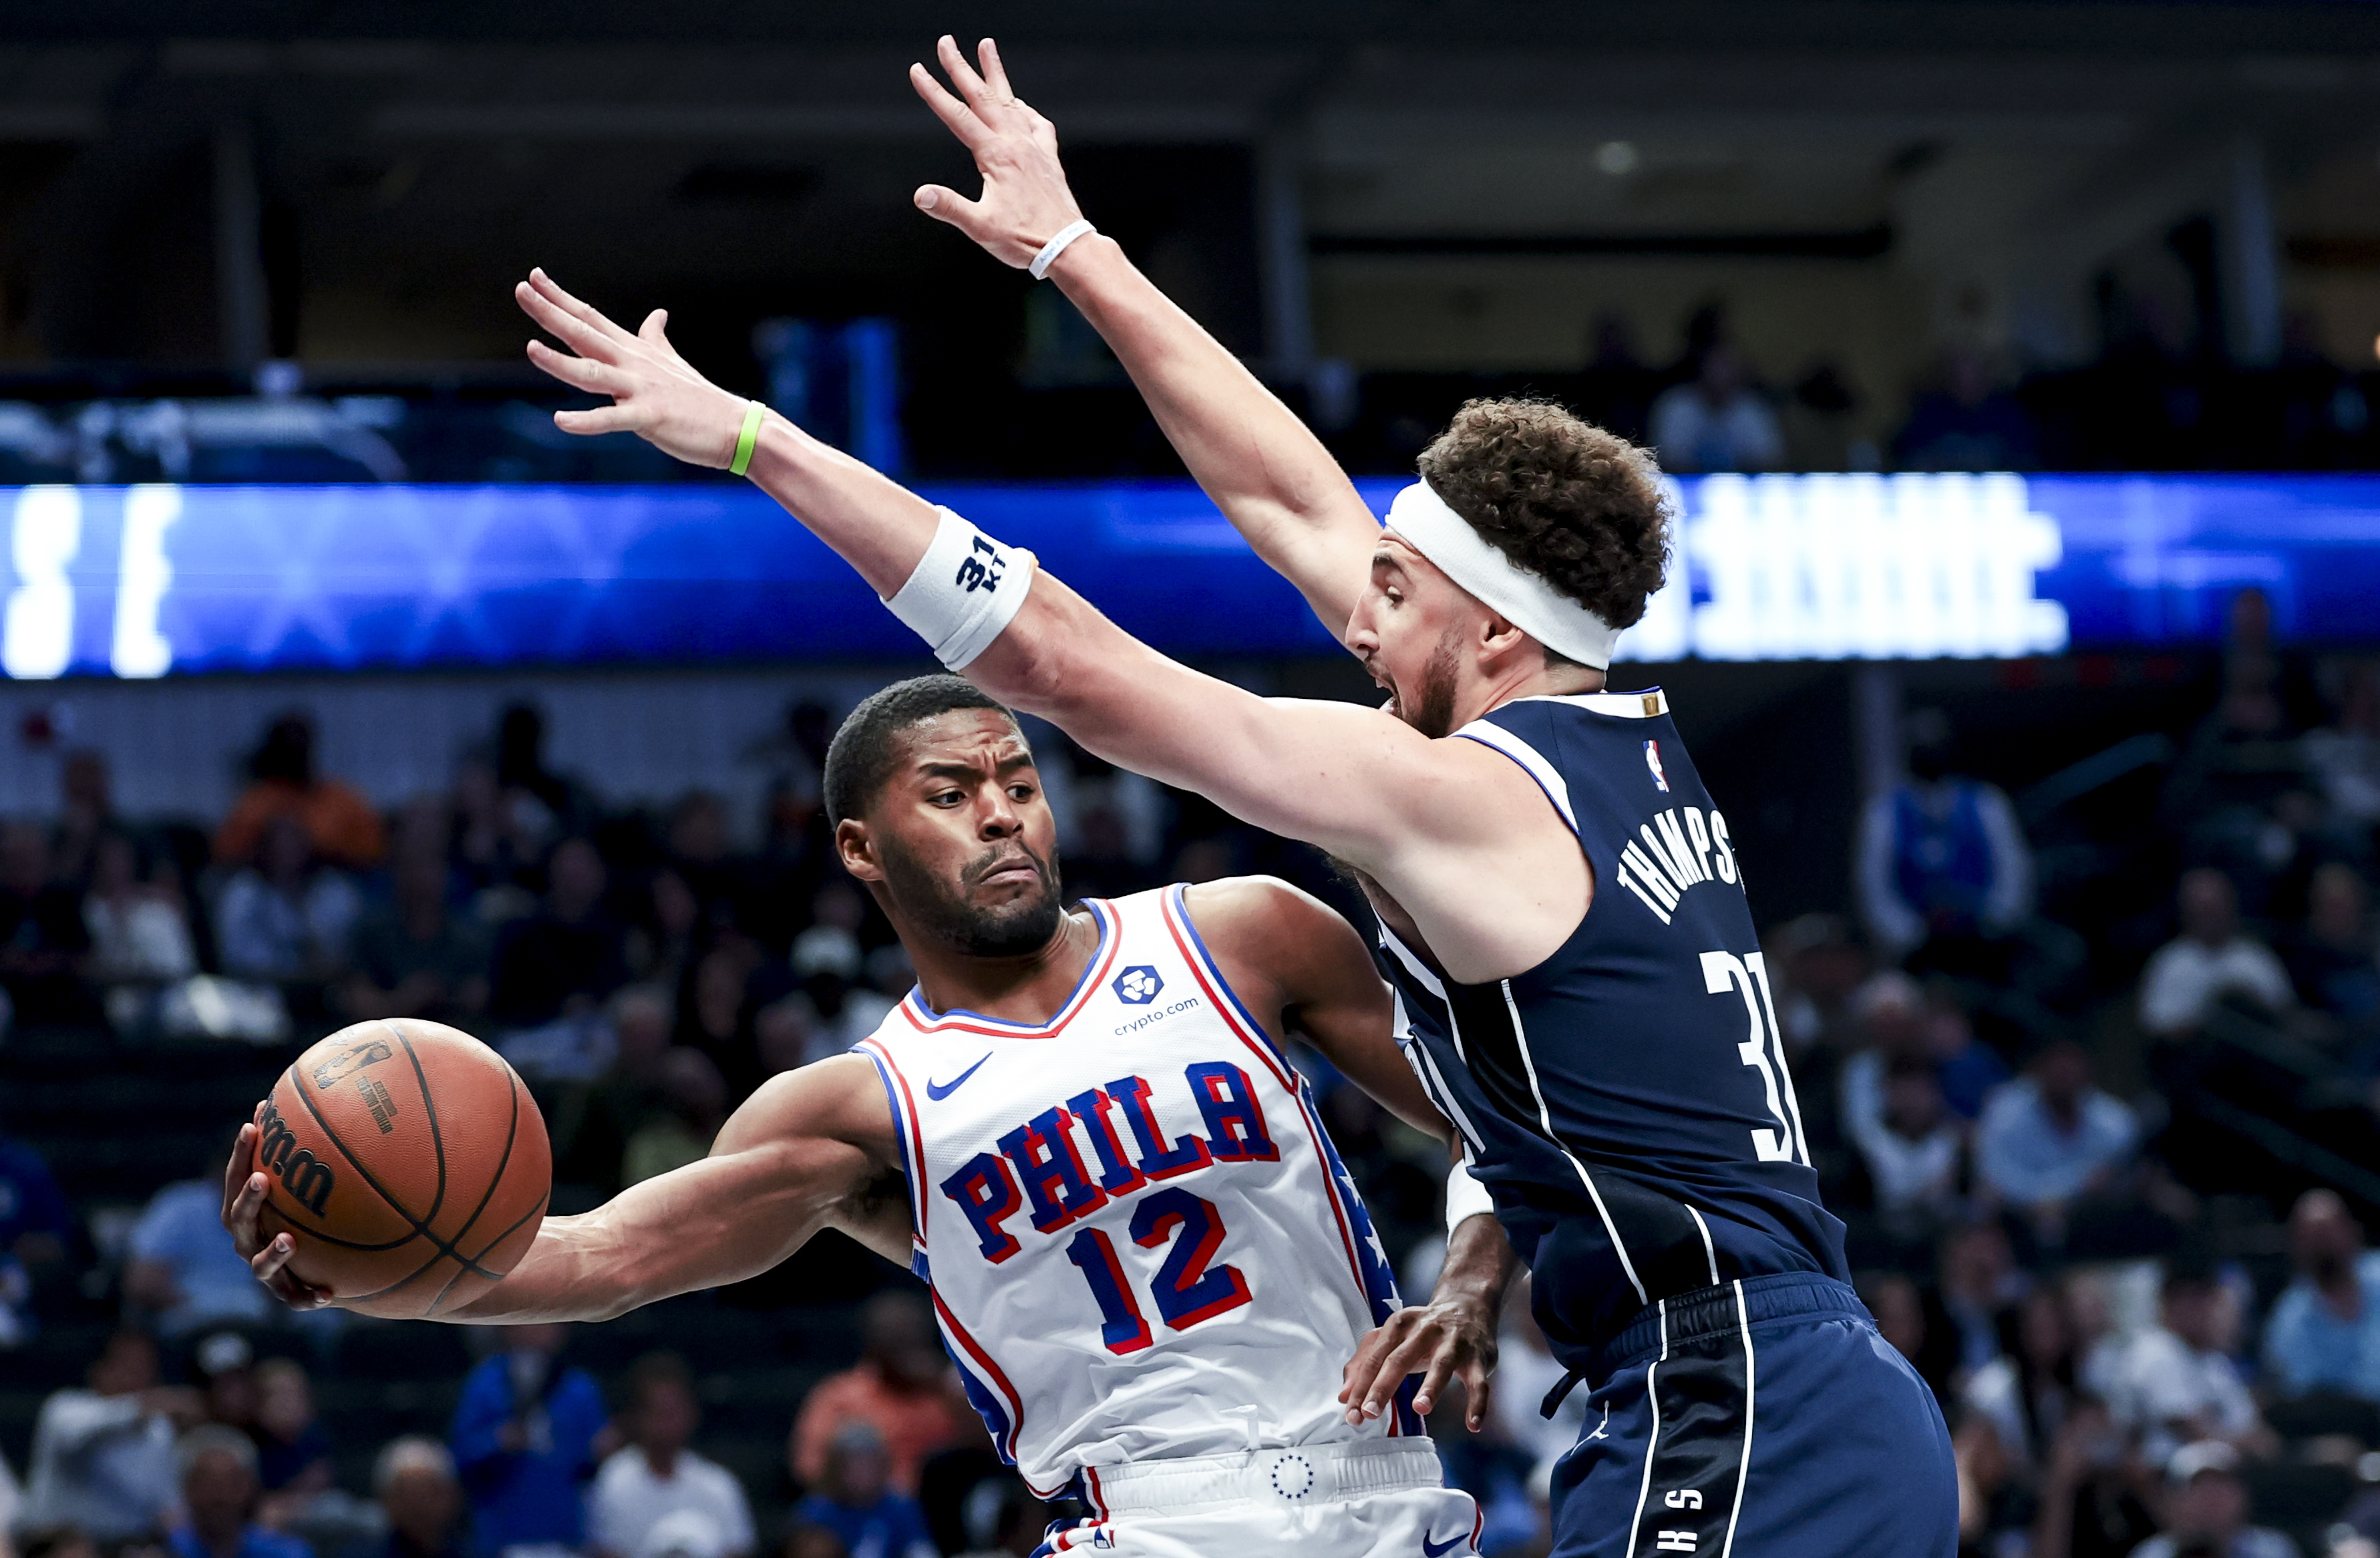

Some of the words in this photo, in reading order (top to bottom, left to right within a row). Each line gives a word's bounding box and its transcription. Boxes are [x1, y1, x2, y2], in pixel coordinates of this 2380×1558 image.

[956, 535, 995, 593] 31
[981, 553, 1006, 593] KT
[1617, 806, 1744, 925] THOMPS
[1115, 998, 1198, 1036] crypto.com
[1699, 951, 1811, 1167] 31
[259, 1091, 333, 1219] Wils
[940, 1061, 1281, 1264] PHILA
[1065, 1187, 1252, 1356] 12
